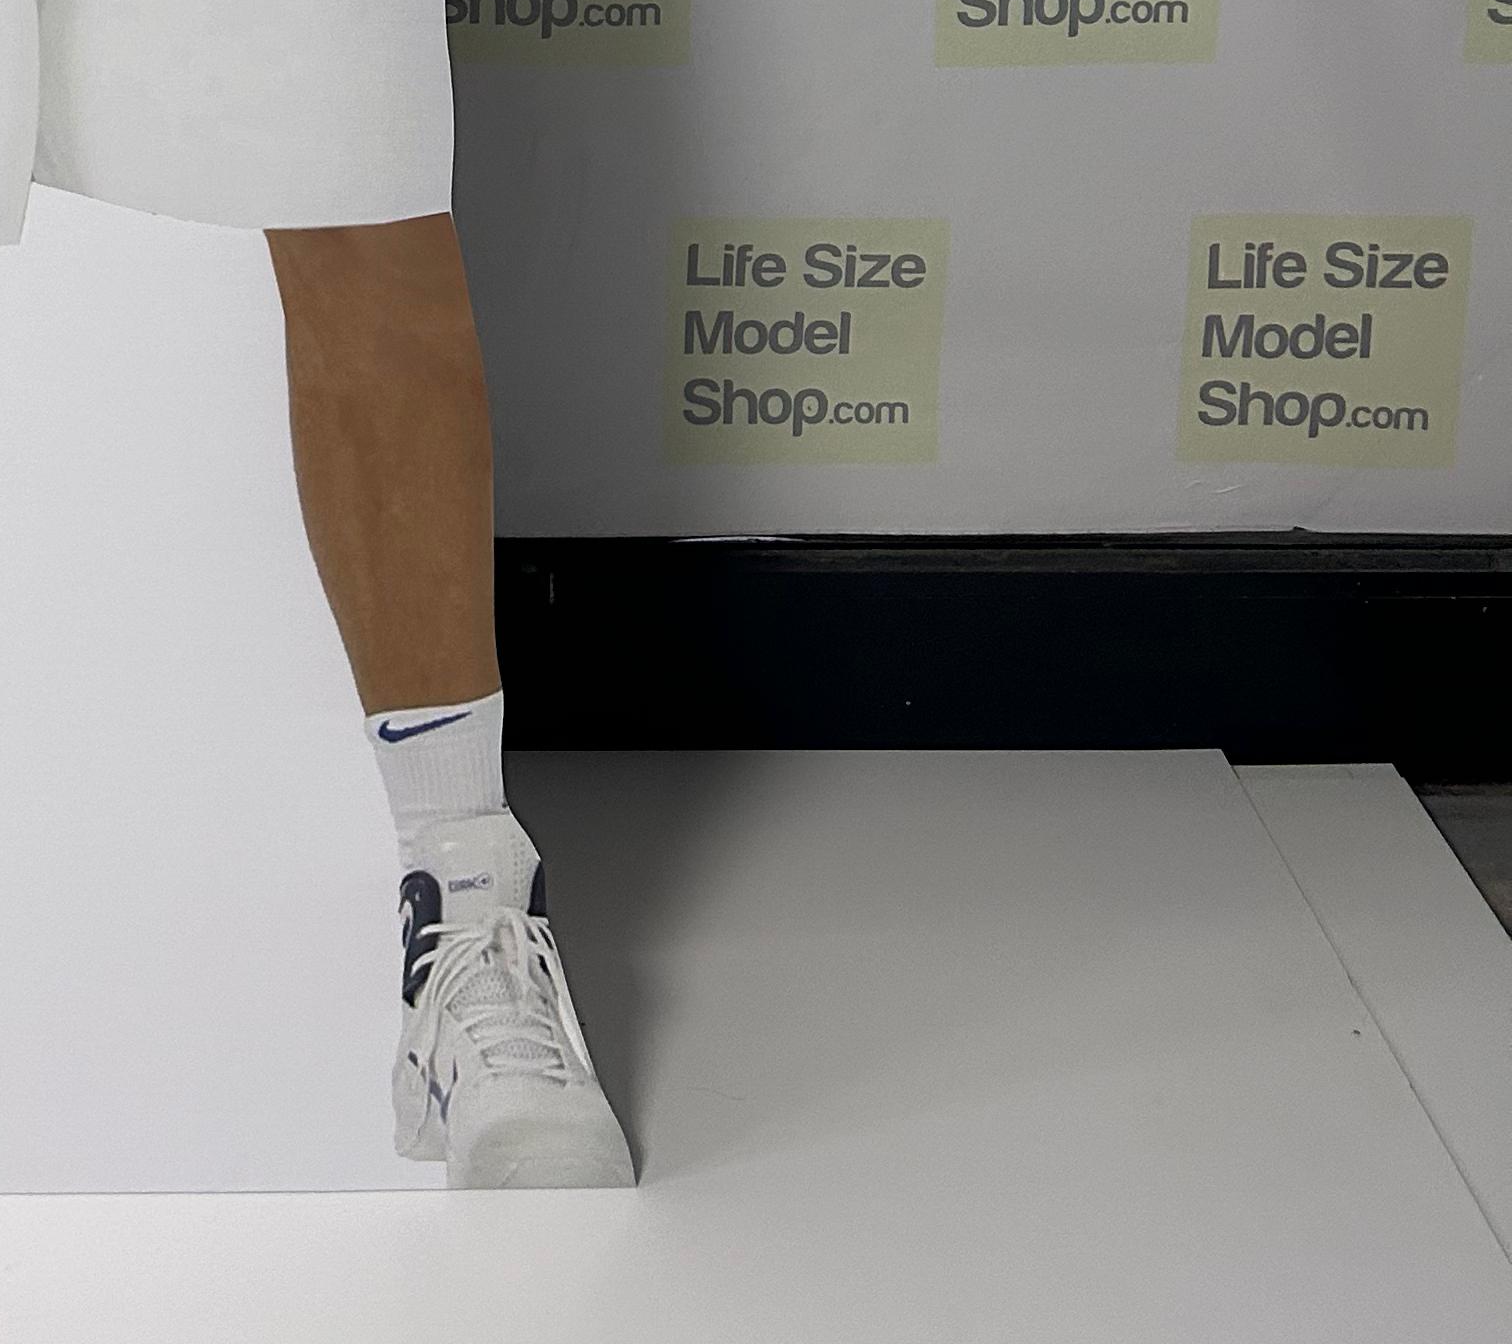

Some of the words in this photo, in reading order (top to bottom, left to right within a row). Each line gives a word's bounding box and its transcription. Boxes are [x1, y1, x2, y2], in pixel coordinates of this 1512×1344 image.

[687, 244, 786, 287] Life
[803, 243, 926, 288] Size
[1208, 242, 1307, 289] Life
[1323, 242, 1449, 289] Size
[684, 311, 851, 355] Model
[1202, 313, 1372, 360] Model
[683, 378, 908, 437] Shop.com
[1198, 380, 1428, 438] Shop.com
